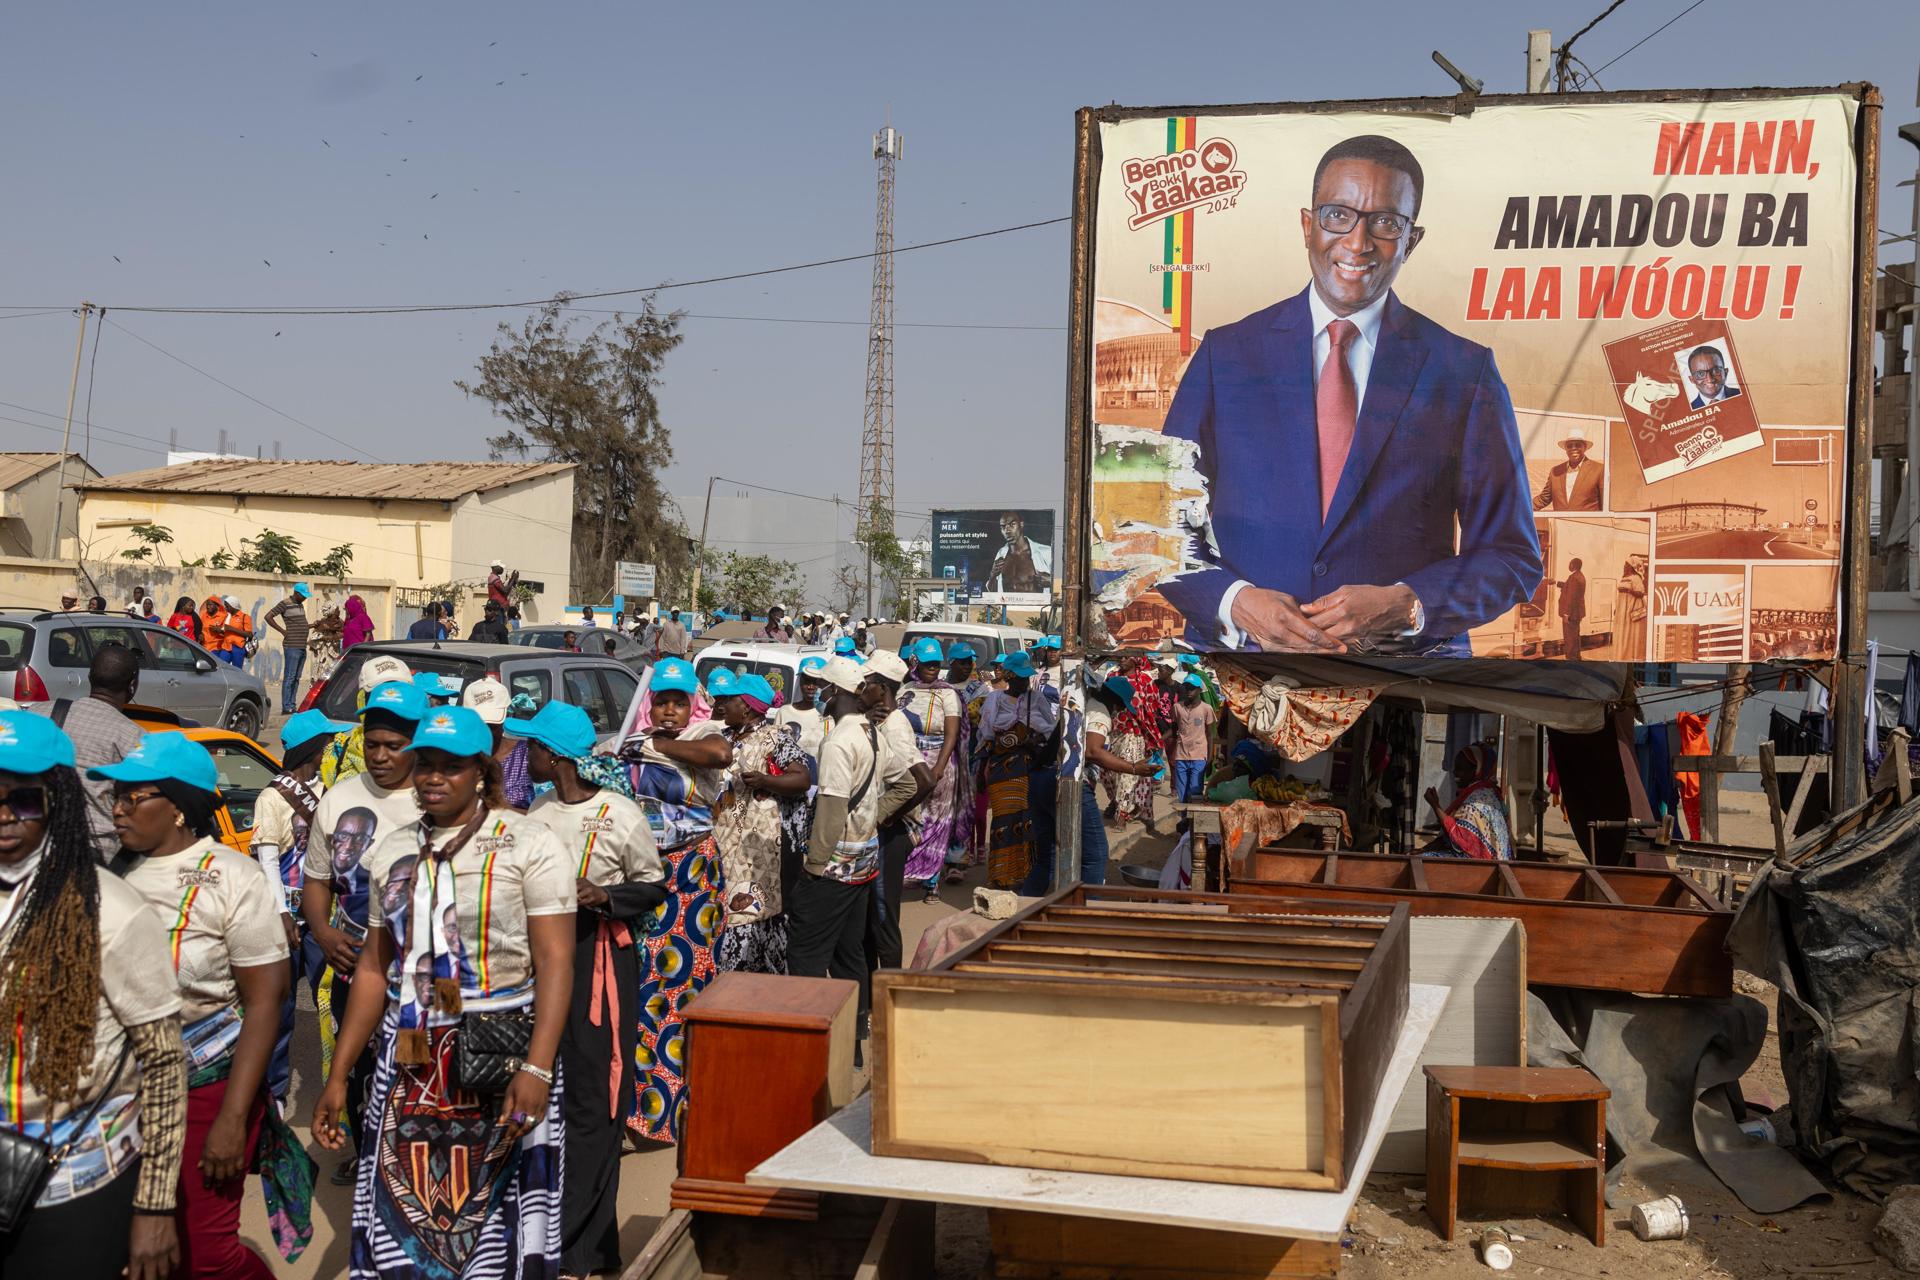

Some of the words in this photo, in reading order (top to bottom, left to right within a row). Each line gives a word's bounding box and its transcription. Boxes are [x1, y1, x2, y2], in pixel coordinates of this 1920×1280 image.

[1653, 119, 1820, 181] MANN,
[1126, 153, 1197, 184] Benno
[1149, 173, 1182, 191] Bokk
[1130, 170, 1243, 215] Yaakaar
[1207, 197, 1237, 214] 2024
[1494, 192, 1729, 250] AMADOU
[1737, 192, 1809, 248] BA
[1466, 267, 1563, 321] LAA
[1577, 256, 1771, 321] WÓOLU
[1660, 412, 1704, 432] Amadou
[1705, 405, 1721, 416] BA
[1676, 434, 1702, 452] Benno
[1682, 436, 1722, 462] Yaakaar
[1694, 591, 1743, 607] UAM
